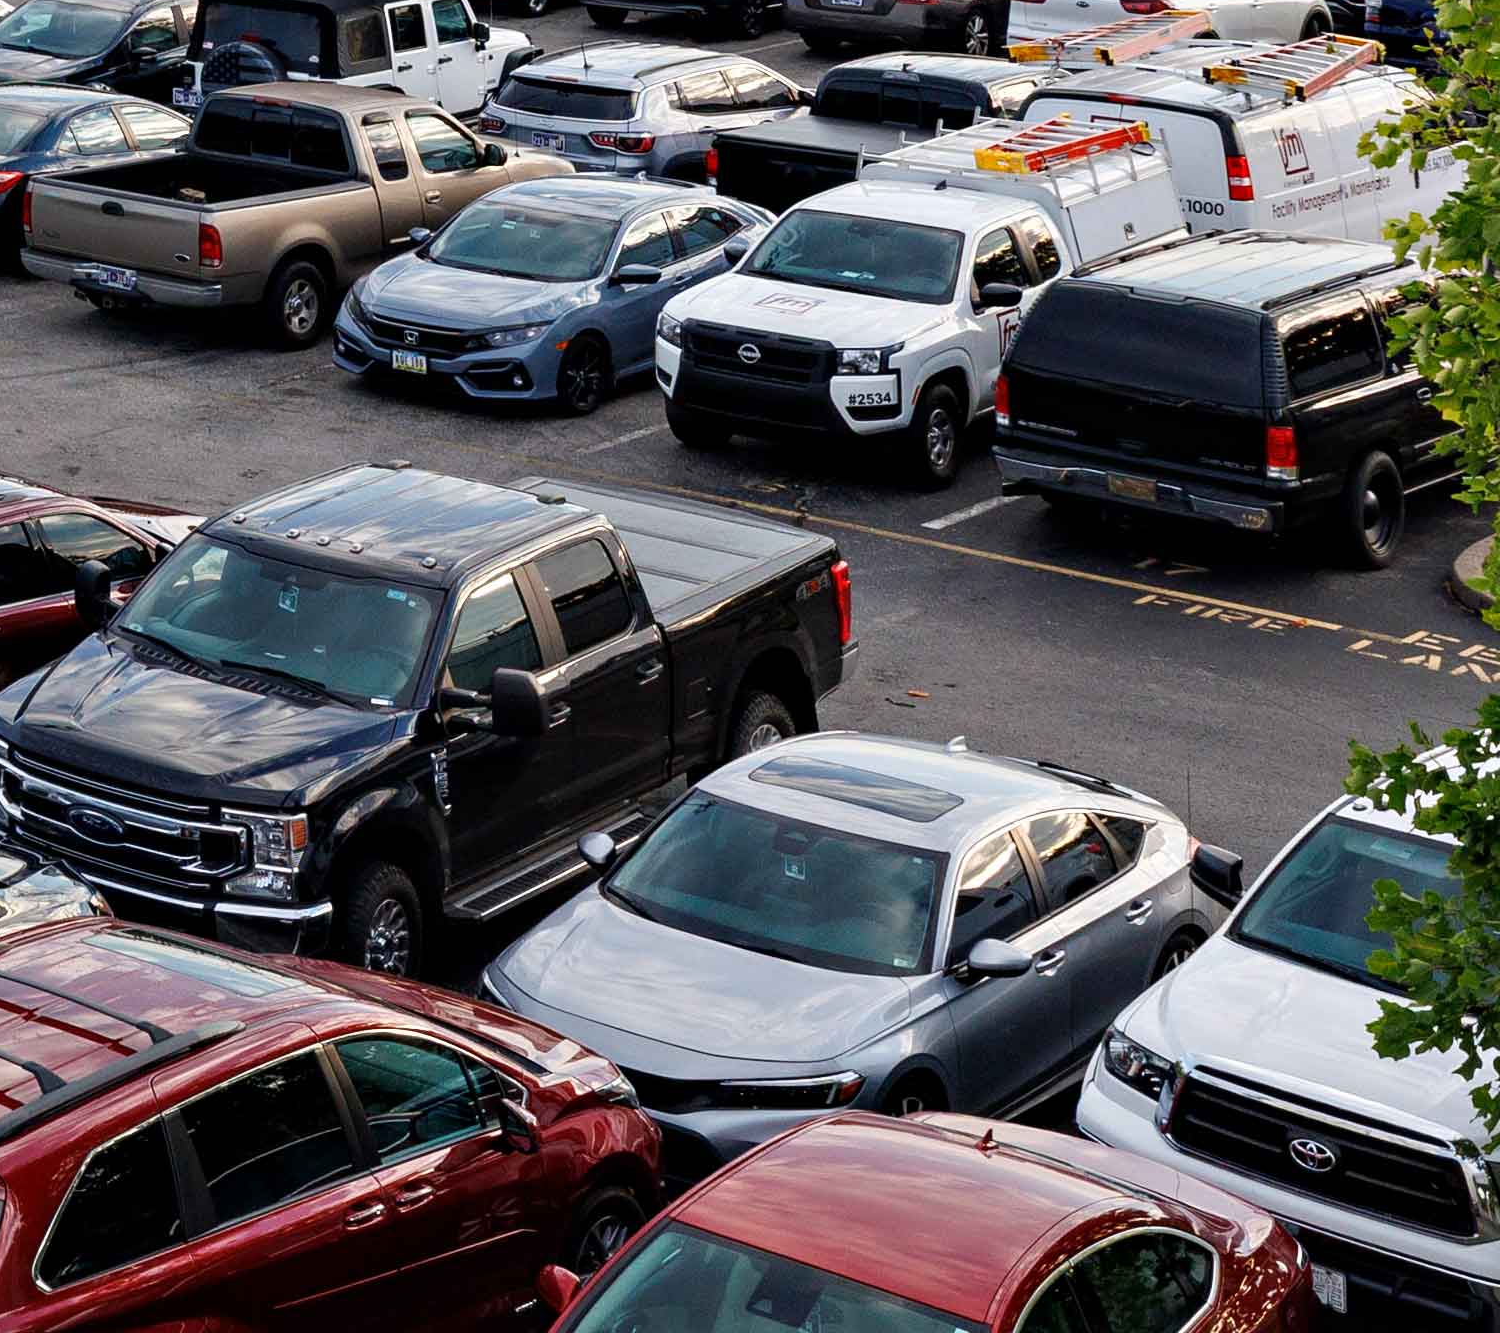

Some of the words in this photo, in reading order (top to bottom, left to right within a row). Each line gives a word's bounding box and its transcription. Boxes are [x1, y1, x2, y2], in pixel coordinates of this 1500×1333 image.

[1272, 200, 1297, 218] Facility
[848, 392, 892, 406] #2534
[1133, 594, 1293, 636] FIRE
